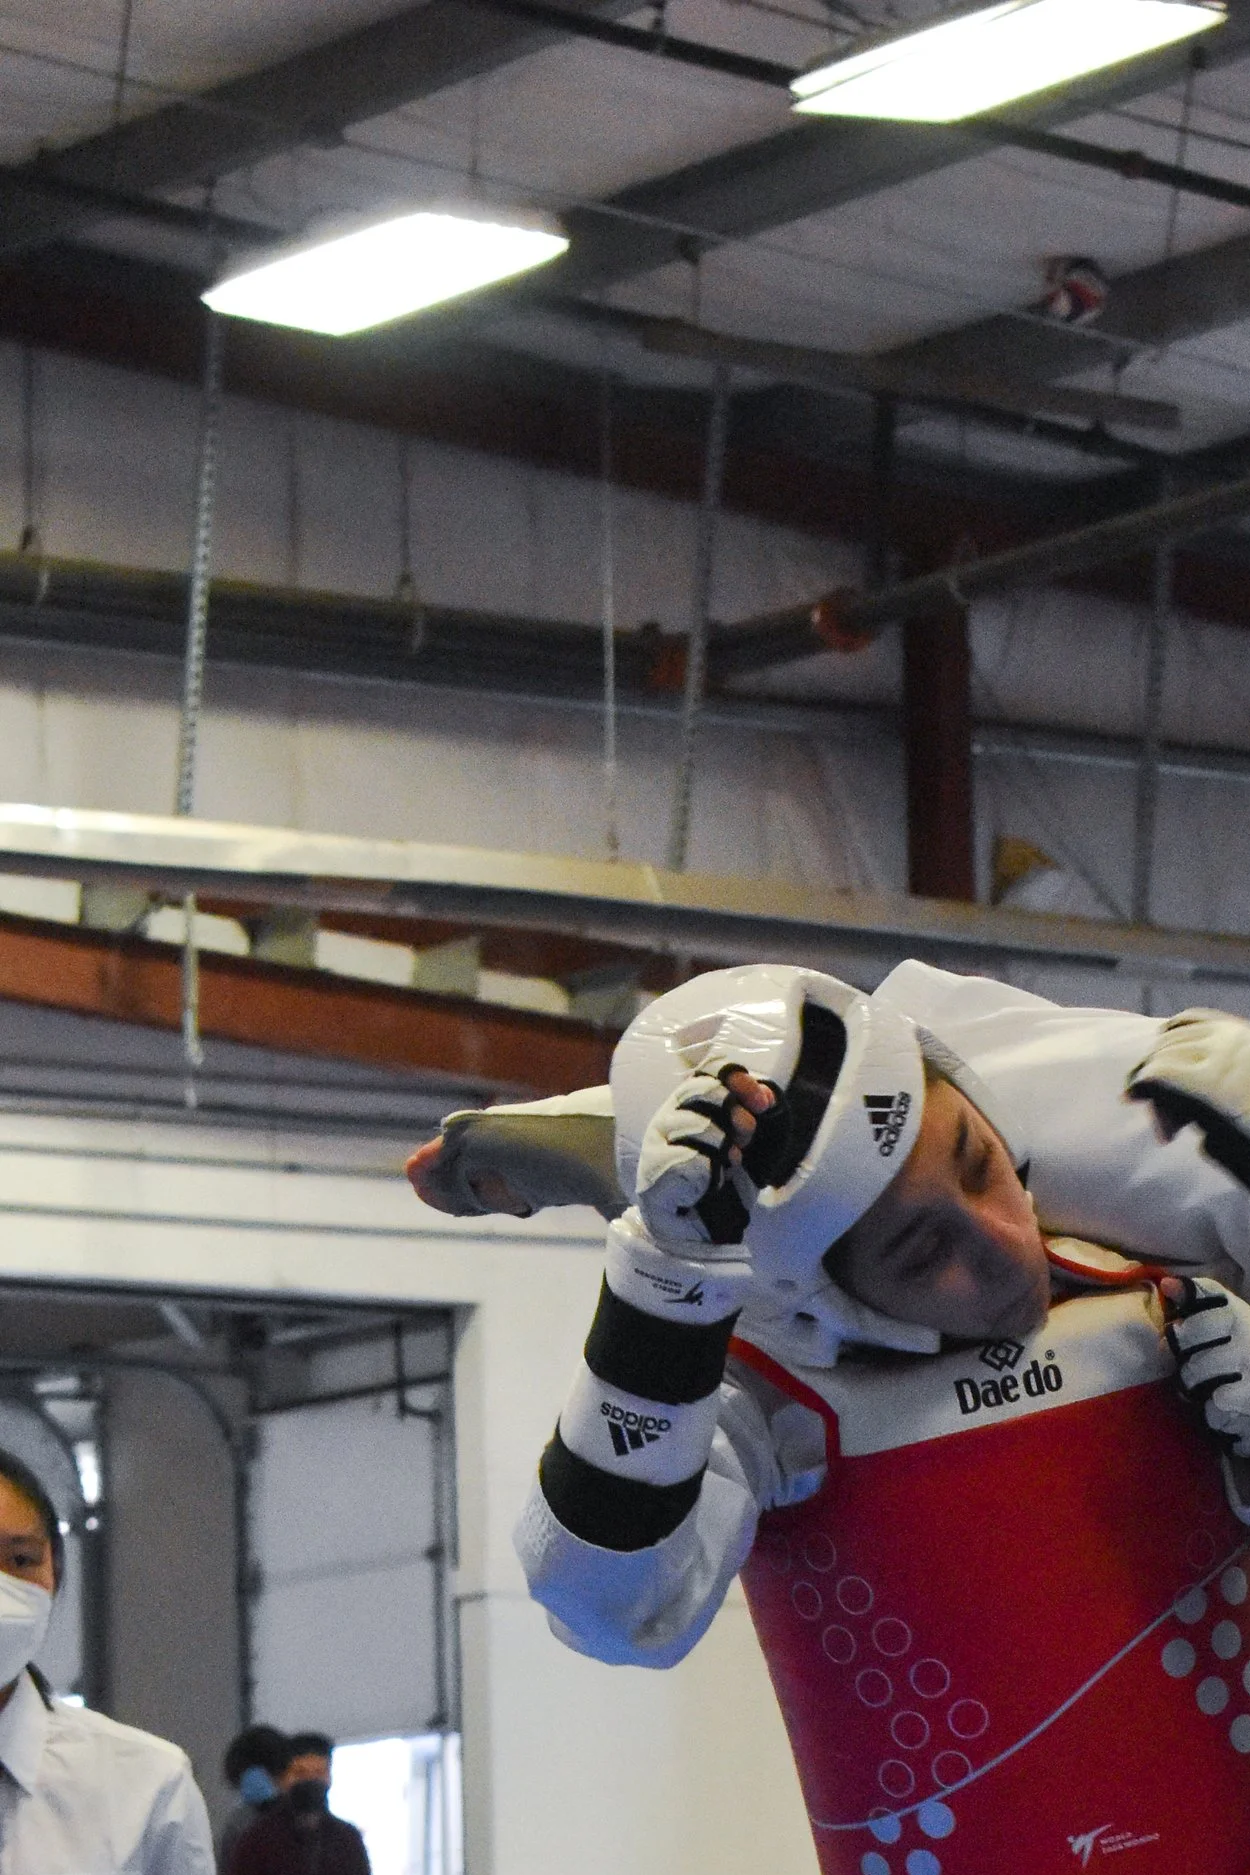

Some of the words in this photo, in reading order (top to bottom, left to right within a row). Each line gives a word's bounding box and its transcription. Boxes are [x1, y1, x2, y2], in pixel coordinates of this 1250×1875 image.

[879, 1091, 911, 1157] adidas
[954, 1360, 1062, 1414] Daedo
[600, 1401, 671, 1432] adidas
